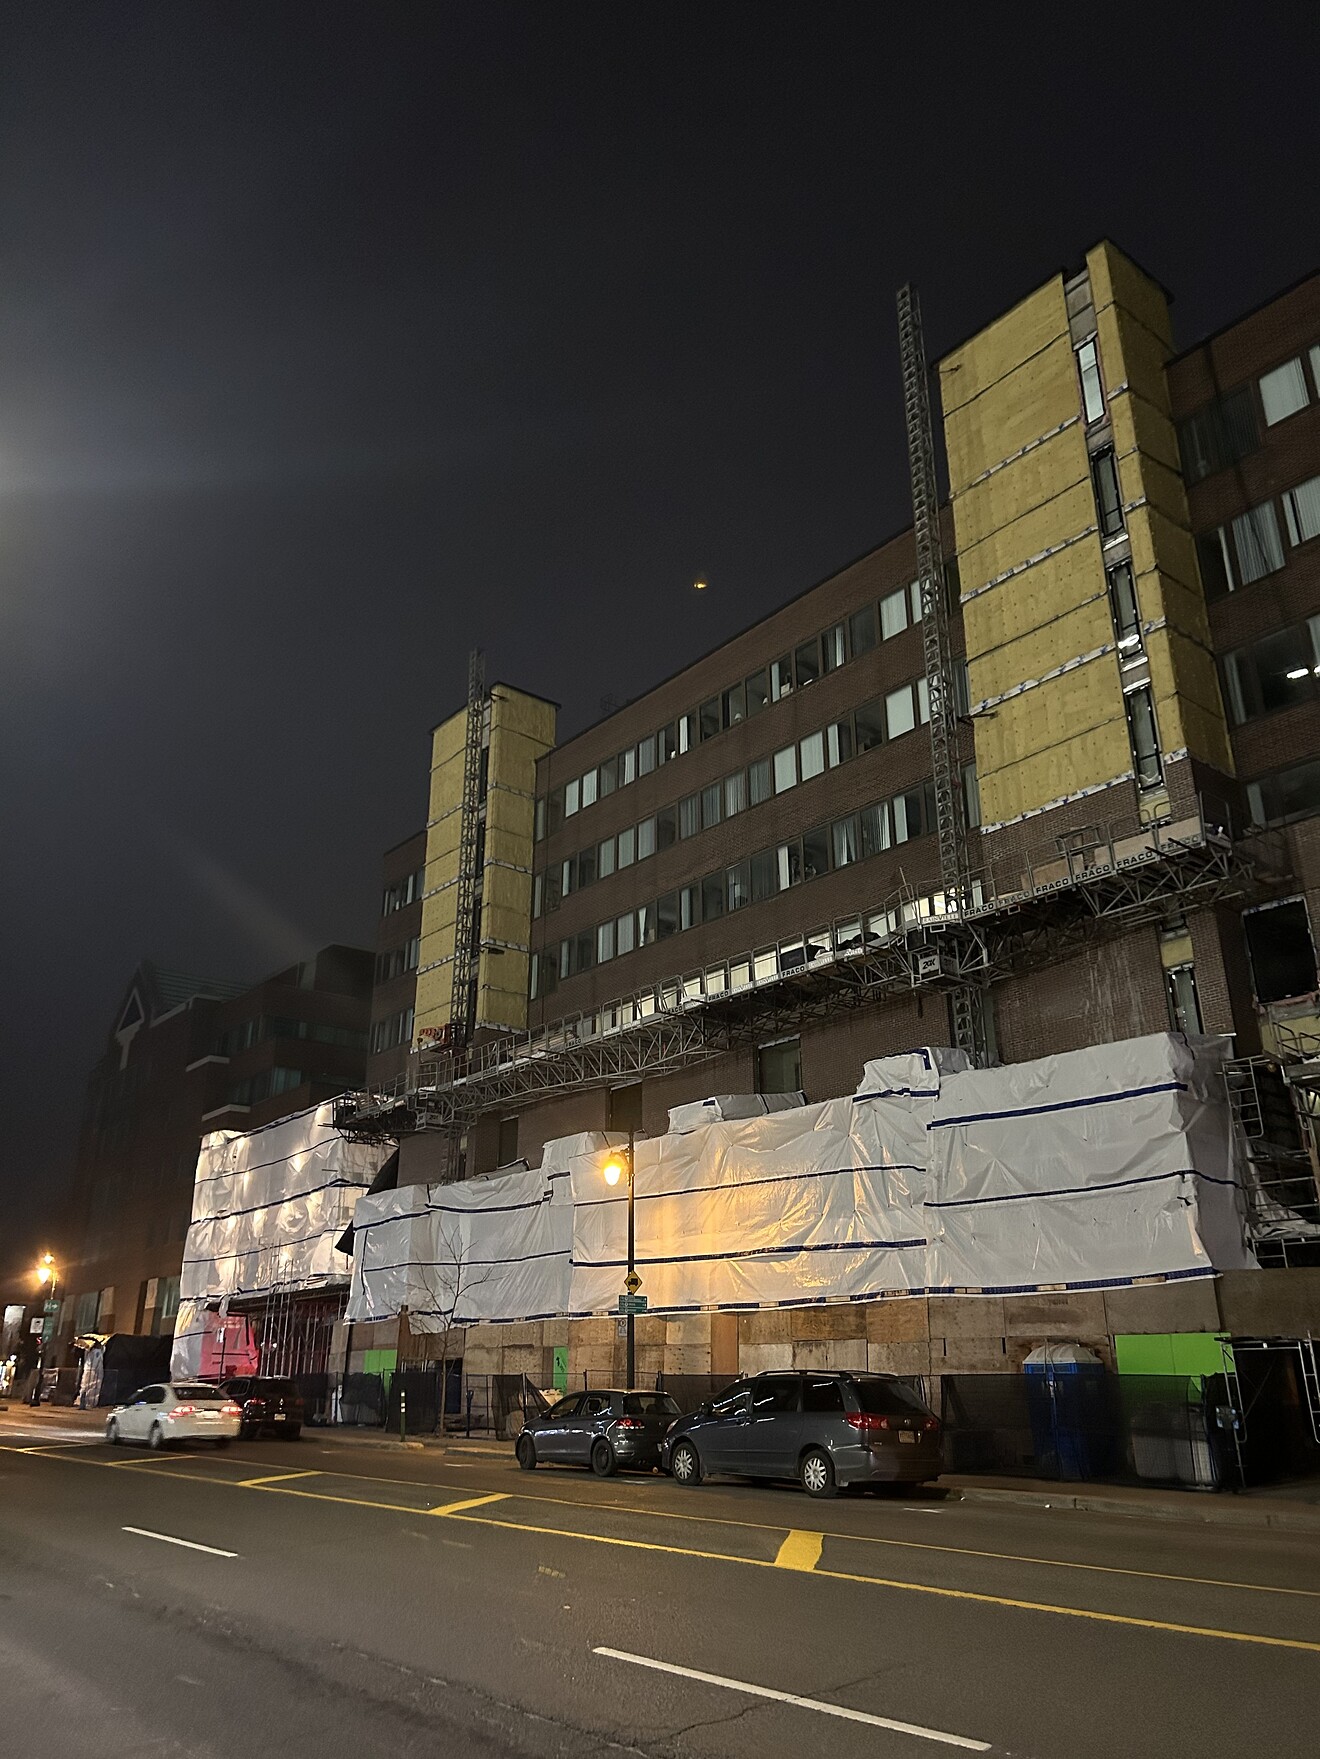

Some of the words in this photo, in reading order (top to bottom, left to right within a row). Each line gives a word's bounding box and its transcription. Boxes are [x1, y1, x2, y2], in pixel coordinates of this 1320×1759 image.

[1161, 835, 1199, 851] FRCO
[1117, 851, 1153, 868] FRACO
[1076, 865, 1110, 881] FRACO
[1036, 878, 1069, 894] FRACO
[964, 902, 994, 918] FRACO
[782, 965, 805, 978] FRACO
[708, 990, 728, 1002] FRACO
